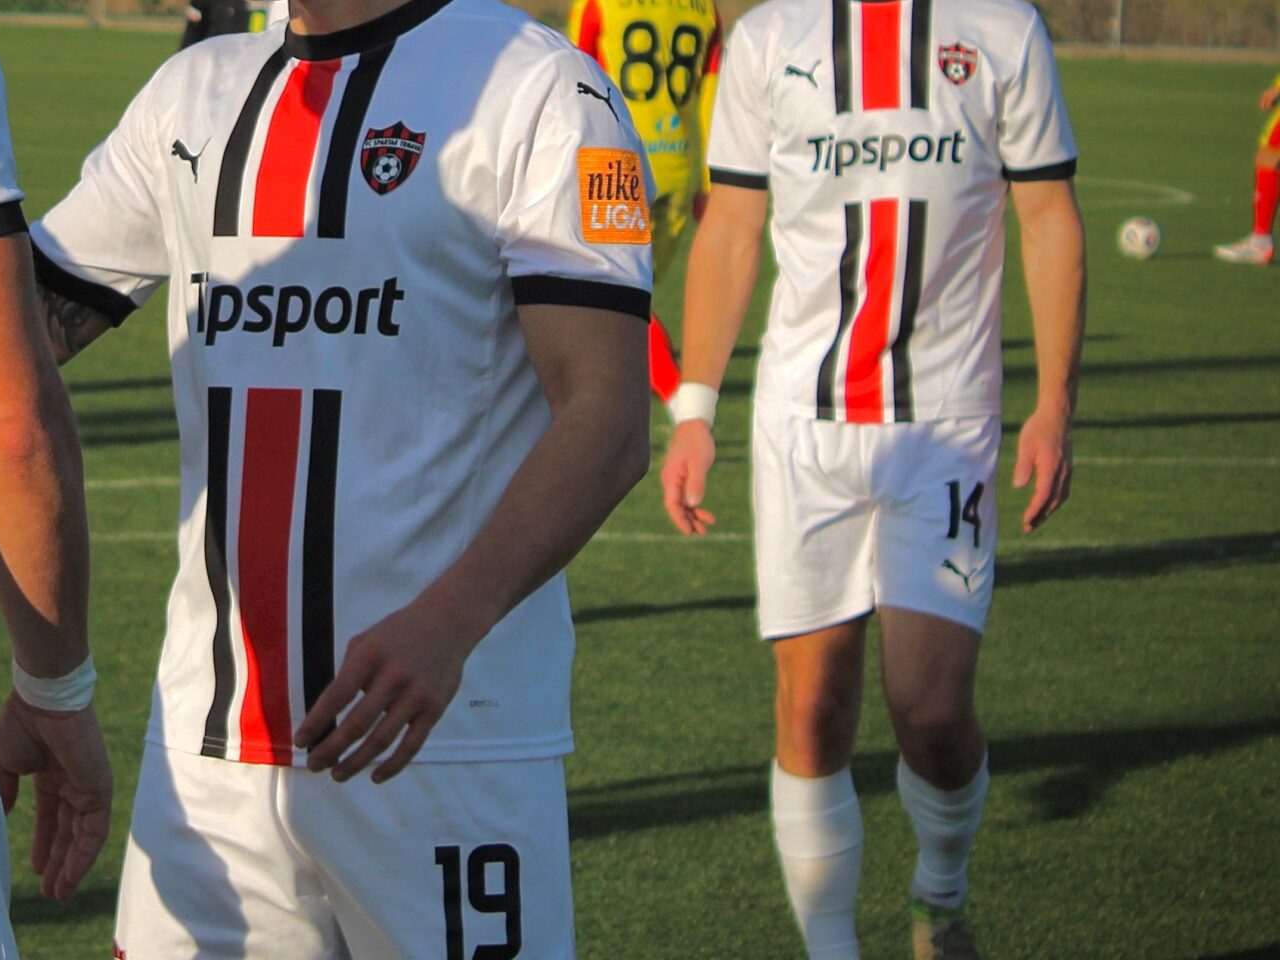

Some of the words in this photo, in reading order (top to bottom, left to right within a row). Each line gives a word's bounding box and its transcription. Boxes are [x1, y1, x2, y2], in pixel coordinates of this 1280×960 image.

[620, 21, 703, 107] 88
[588, 160, 640, 201] niké
[807, 130, 966, 176] Tipsport
[591, 204, 646, 230] LIGA
[945, 480, 984, 548] 14
[434, 843, 522, 960] 19
